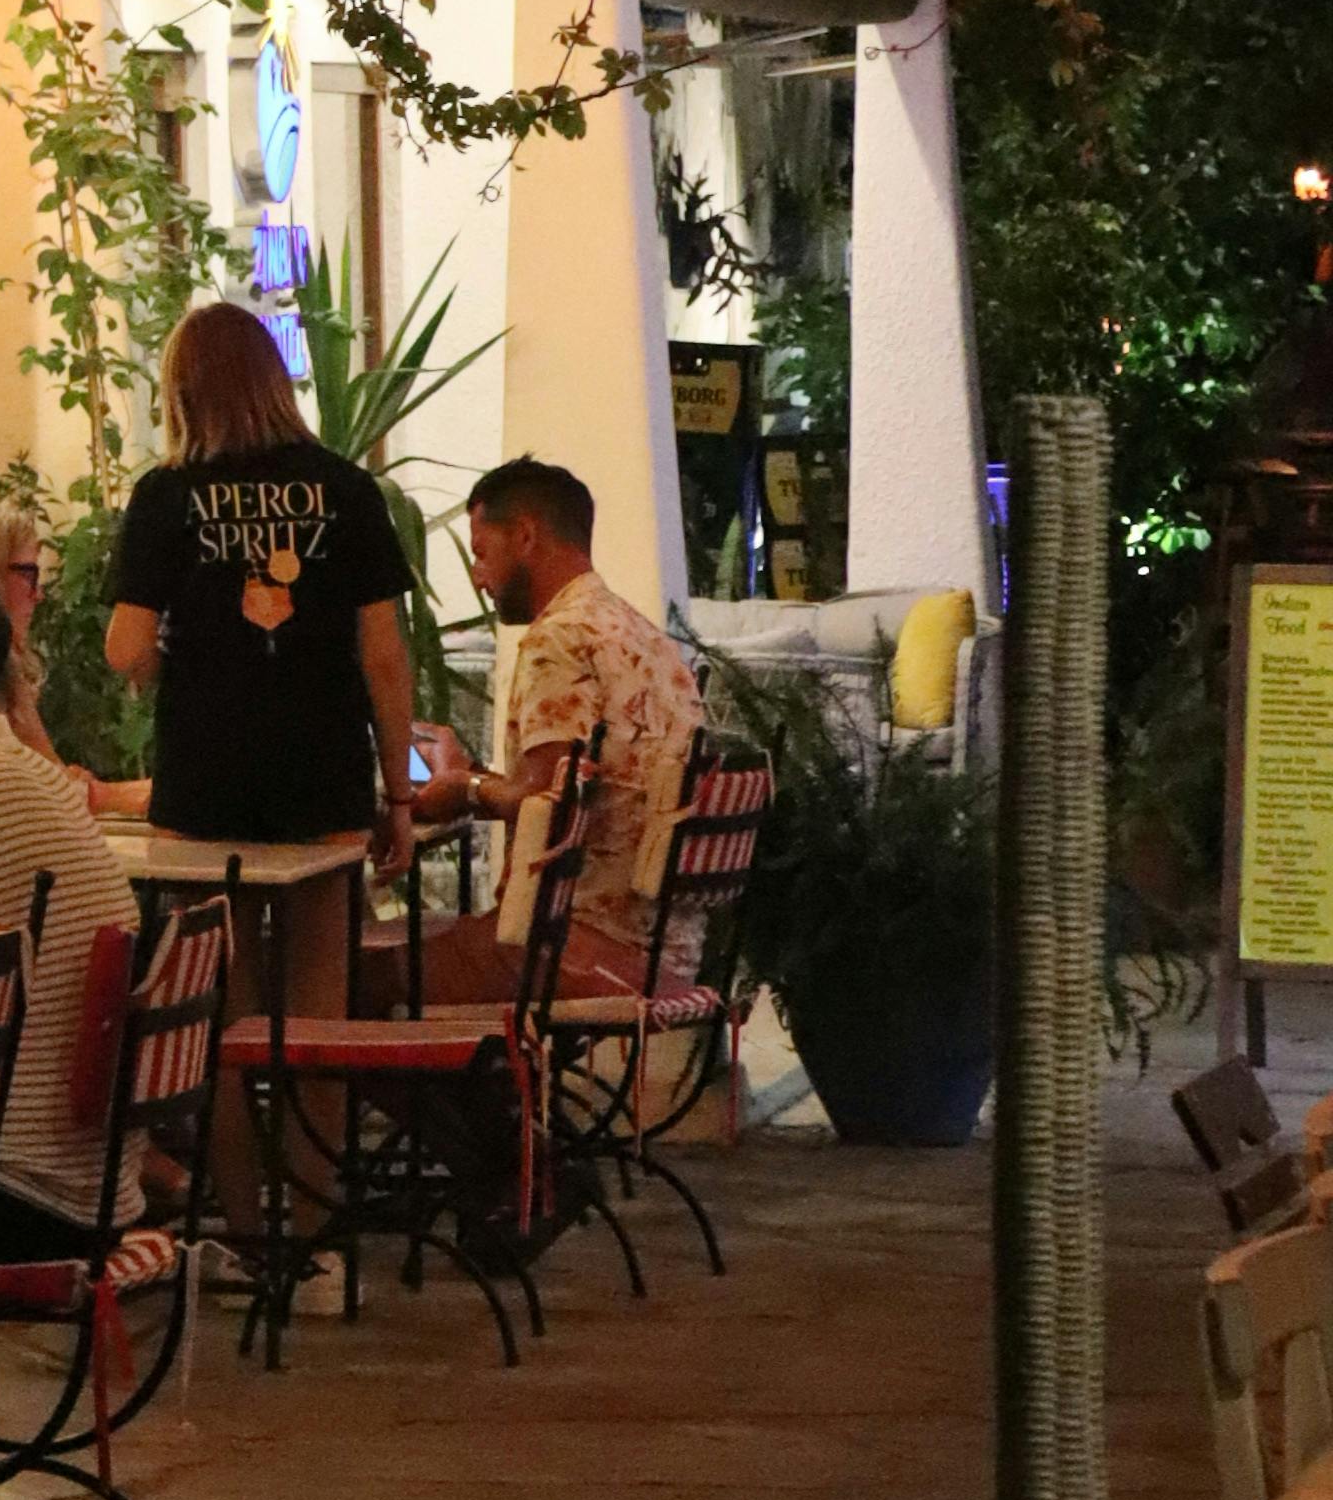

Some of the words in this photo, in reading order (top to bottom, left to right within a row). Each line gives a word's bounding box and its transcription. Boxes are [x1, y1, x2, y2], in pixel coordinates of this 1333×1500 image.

[673, 386, 727, 406] BORG
[185, 481, 337, 525] APEROL
[199, 519, 326, 563] SPRITZ
